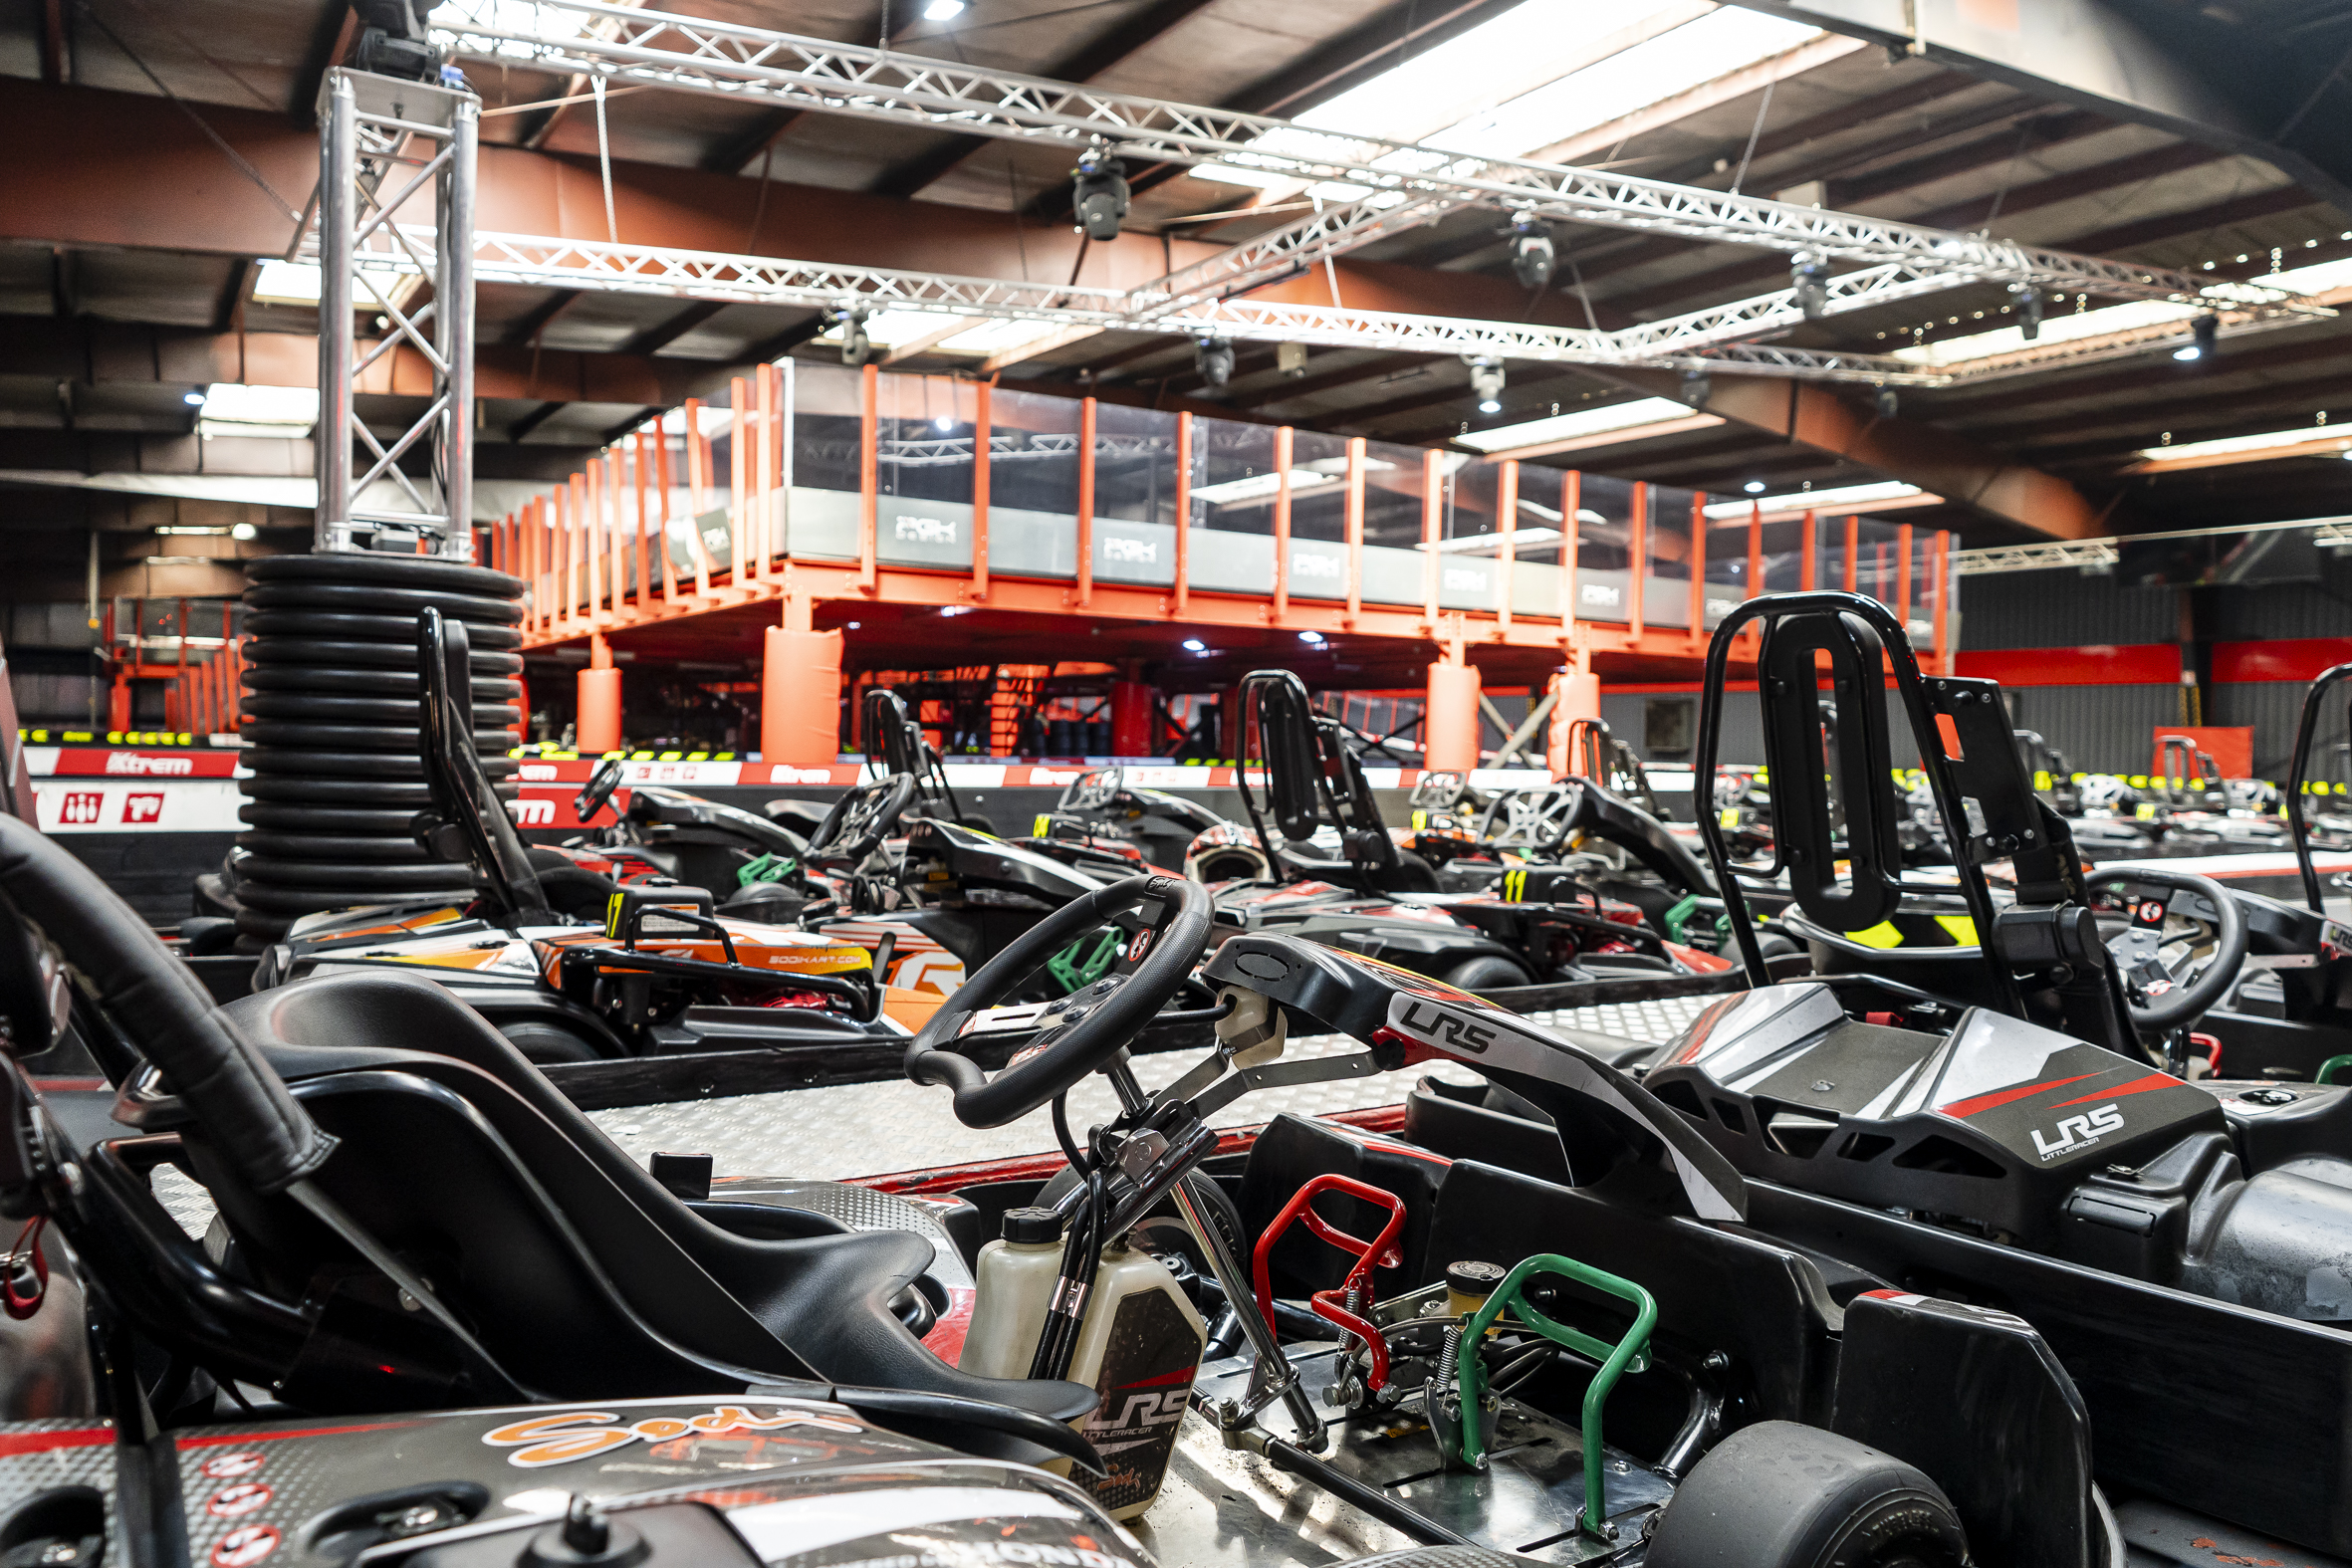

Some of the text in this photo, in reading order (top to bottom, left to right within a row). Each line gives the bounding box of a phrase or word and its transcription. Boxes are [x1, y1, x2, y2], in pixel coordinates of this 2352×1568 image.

[1505, 869, 1528, 904] 11
[605, 892, 624, 938] 17
[1400, 1001, 1498, 1054] LRS
[2029, 1103, 2125, 1156] LRS
[2040, 1136, 2100, 1162] LITTLERACER
[1081, 1388, 1192, 1432] LRS
[481, 1404, 863, 1468] Sodi
